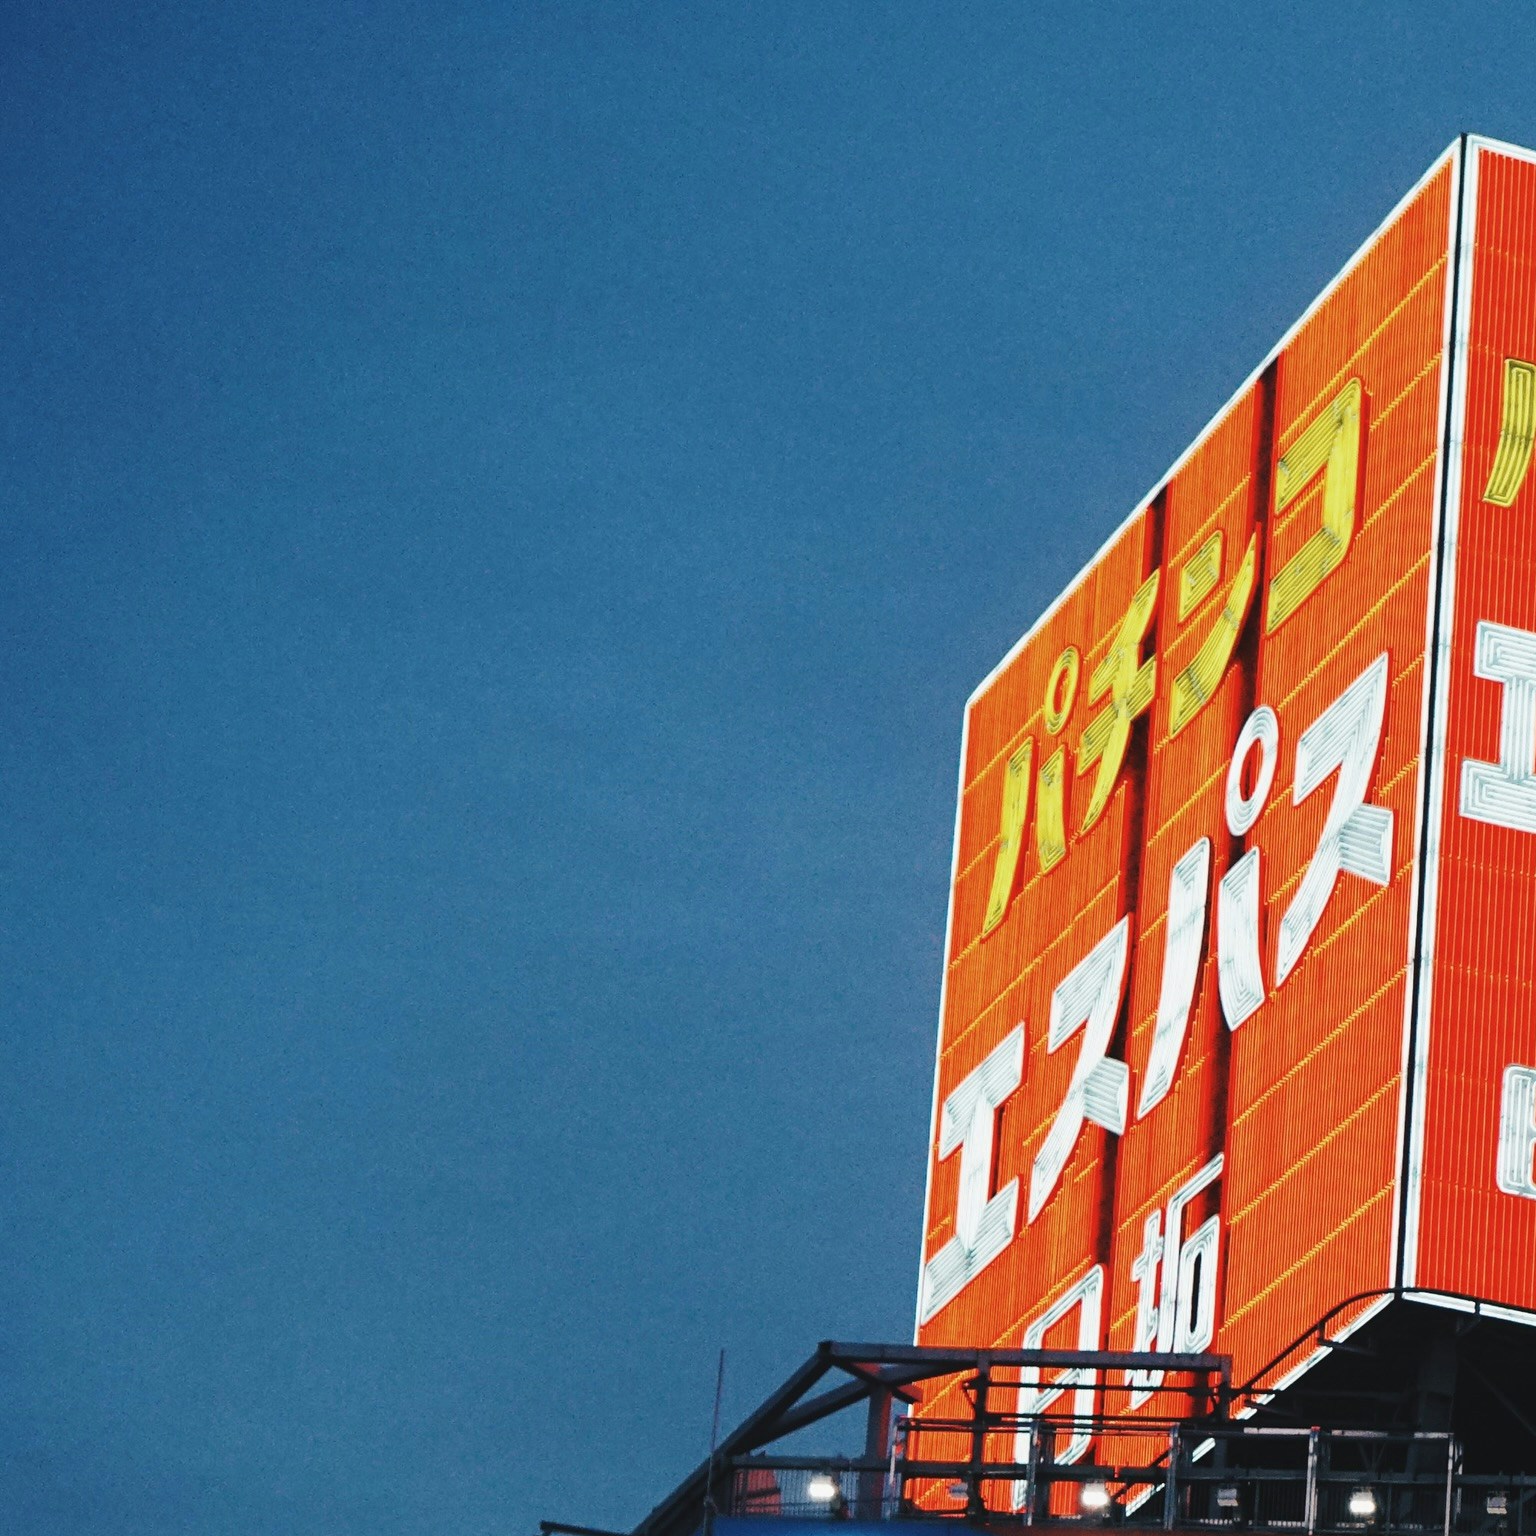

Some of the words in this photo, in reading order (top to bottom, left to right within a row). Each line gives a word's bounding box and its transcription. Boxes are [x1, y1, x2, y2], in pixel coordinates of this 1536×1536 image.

[982, 377, 1363, 941] パチンコ
[920, 651, 1394, 1327] エスパス
